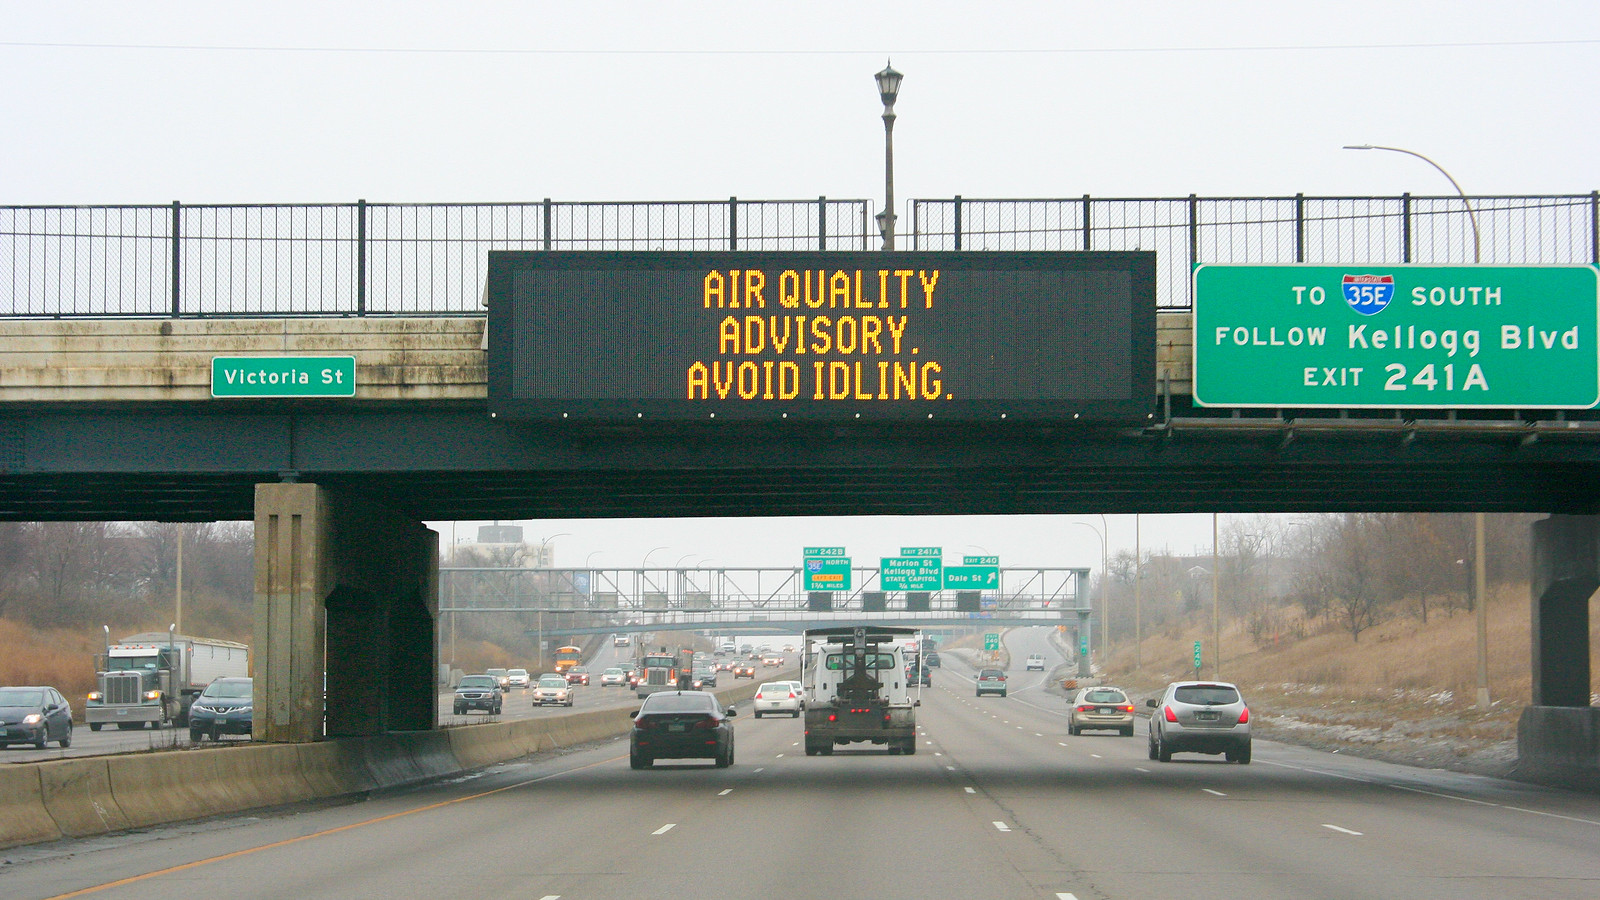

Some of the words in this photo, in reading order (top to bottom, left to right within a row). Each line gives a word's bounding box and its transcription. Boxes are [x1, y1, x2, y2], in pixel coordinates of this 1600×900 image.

[704, 269, 765, 309] AIR
[778, 269, 940, 309] QUALITY
[1292, 286, 1326, 306] TO
[1347, 286, 1387, 306] 35E
[1411, 286, 1502, 306] SOUTH
[719, 315, 920, 355] ADVISORY.
[1215, 327, 1326, 346] FOLLOW
[1348, 325, 1481, 357] Kellogg
[1500, 325, 1579, 350] Blvd
[224, 369, 309, 384] Victoria
[321, 369, 343, 384] St
[687, 360, 800, 400] AVOID
[813, 360, 954, 400] IDLING.
[1303, 367, 1363, 386] EXIT
[1384, 363, 1490, 391] 241A
[808, 562, 821, 570] 35E
[884, 567, 916, 576] Kellogg
[919, 567, 939, 575] Blvd
[889, 559, 920, 567] Marion
[922, 559, 933, 567] St
[948, 574, 968, 582] Dale
[971, 574, 982, 582] St
